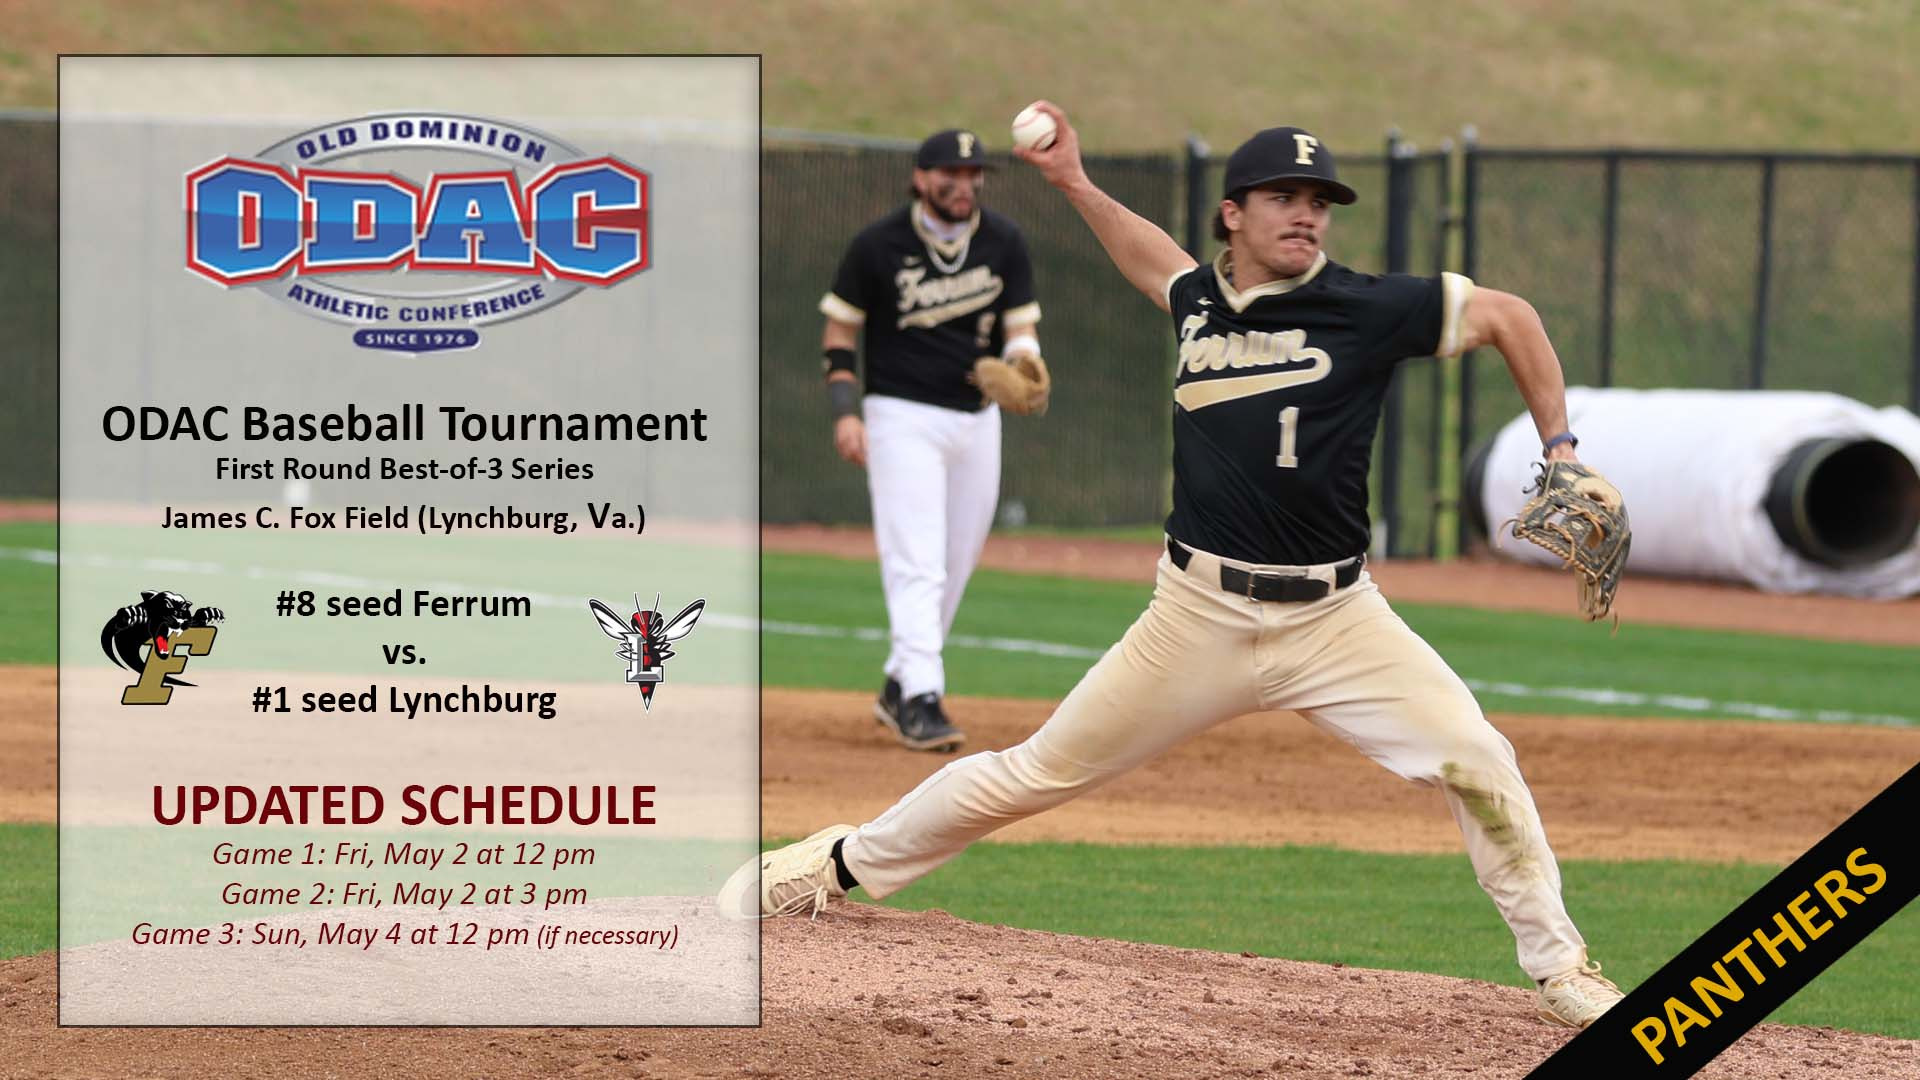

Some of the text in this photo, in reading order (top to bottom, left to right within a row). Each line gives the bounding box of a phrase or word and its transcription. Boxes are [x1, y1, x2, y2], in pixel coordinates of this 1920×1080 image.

[1292, 133, 1319, 166] F
[1175, 311, 1309, 379] Ferrum
[1276, 406, 1300, 469] 1
